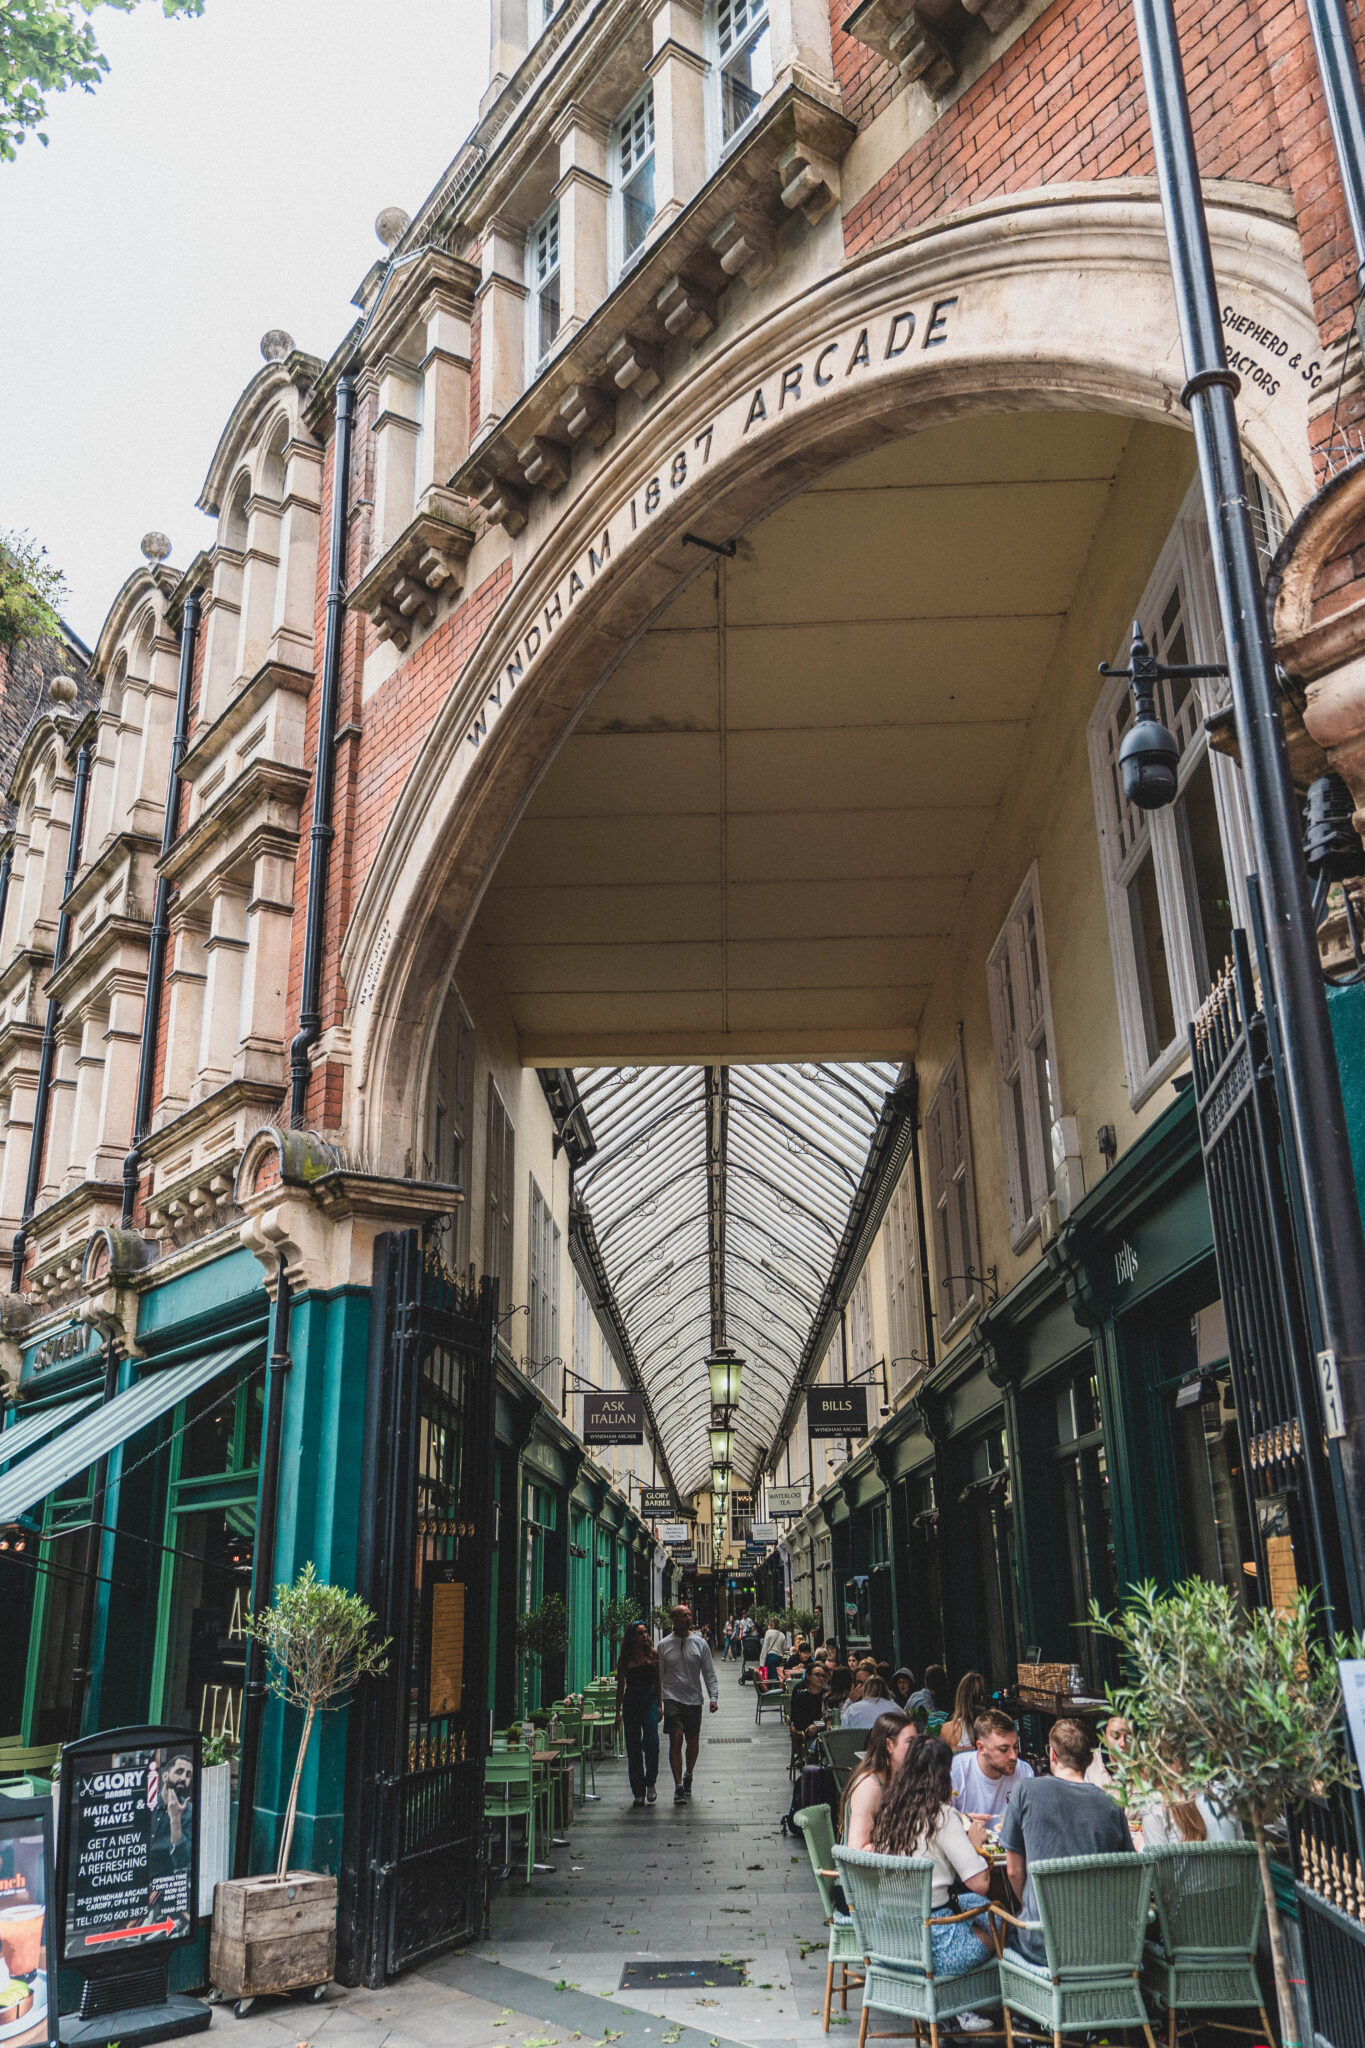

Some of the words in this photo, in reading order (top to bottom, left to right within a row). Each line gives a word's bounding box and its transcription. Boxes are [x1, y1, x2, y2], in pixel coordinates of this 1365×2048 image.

[1222, 306, 1288, 357] SHEPHERD
[1288, 353, 1302, 370] &
[466, 529, 611, 748] WYNDHAM
[630, 424, 714, 531] 1887
[743, 296, 958, 434] ARCADE
[368, 931, 391, 1001] ARCHITECT
[602, 1401, 625, 1411] ASK
[822, 1400, 853, 1411] BILLS
[591, 1413, 636, 1424] ITALIAN
[769, 1492, 801, 1500] WATERLOO
[93, 1770, 145, 1792] GLORY
[105, 1788, 132, 1800] BARBER
[83, 1804, 109, 1818] HAIR
[113, 1800, 134, 1813] CUT
[136, 1798, 145, 1810] &
[93, 1811, 135, 1827] SHAVES
[88, 1836, 107, 1850] GET
[109, 1835, 116, 1847] A
[118, 1832, 141, 1846] NEW
[80, 1850, 104, 1864] HAIR
[105, 1847, 126, 1860] CUT
[127, 1843, 147, 1856] FOR
[78, 1865, 86, 1877] A
[88, 1855, 147, 1875] REFRESHING
[91, 1870, 133, 1887] CHANGE
[152, 1875, 175, 1885] OPENING
[175, 1873, 187, 1881] TIME
[155, 1882, 168, 1890] DAYS
[93, 1892, 124, 1904] WYNDHAM
[124, 1887, 148, 1898] ARCADE
[75, 1916, 92, 1927] TEL:
[93, 1912, 113, 1924] 0750
[114, 1910, 129, 1920] 600
[129, 1906, 148, 1918] 3875
